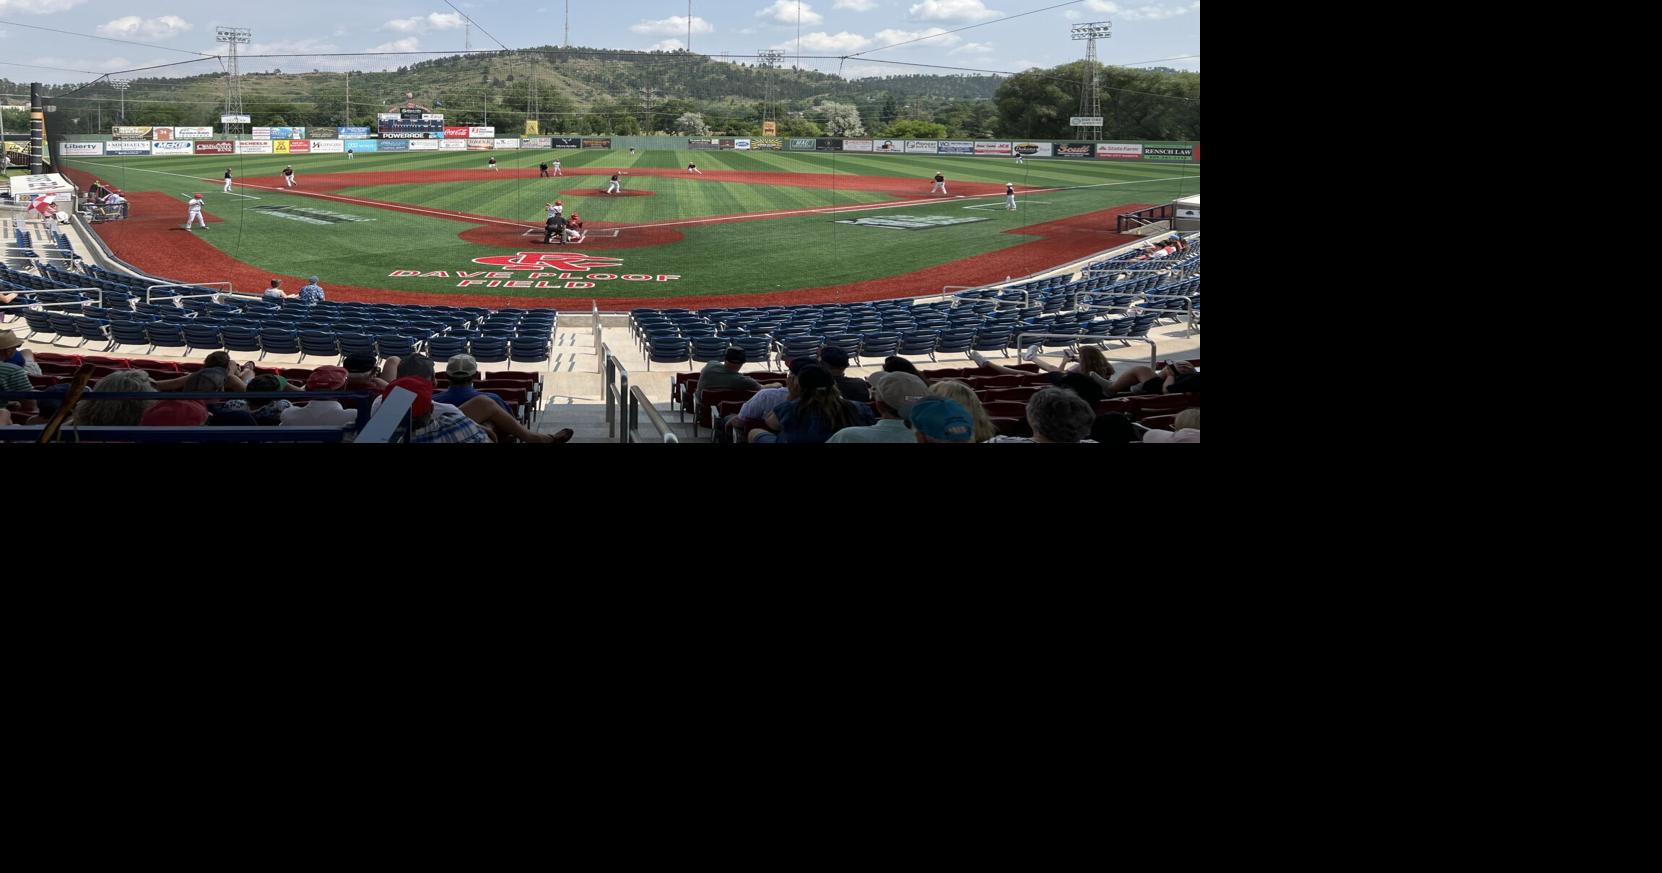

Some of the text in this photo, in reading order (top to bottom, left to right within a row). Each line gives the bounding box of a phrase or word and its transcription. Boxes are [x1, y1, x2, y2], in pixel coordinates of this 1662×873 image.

[388, 270, 681, 282] DAVE PLOOF
[456, 279, 596, 289] FIELD
